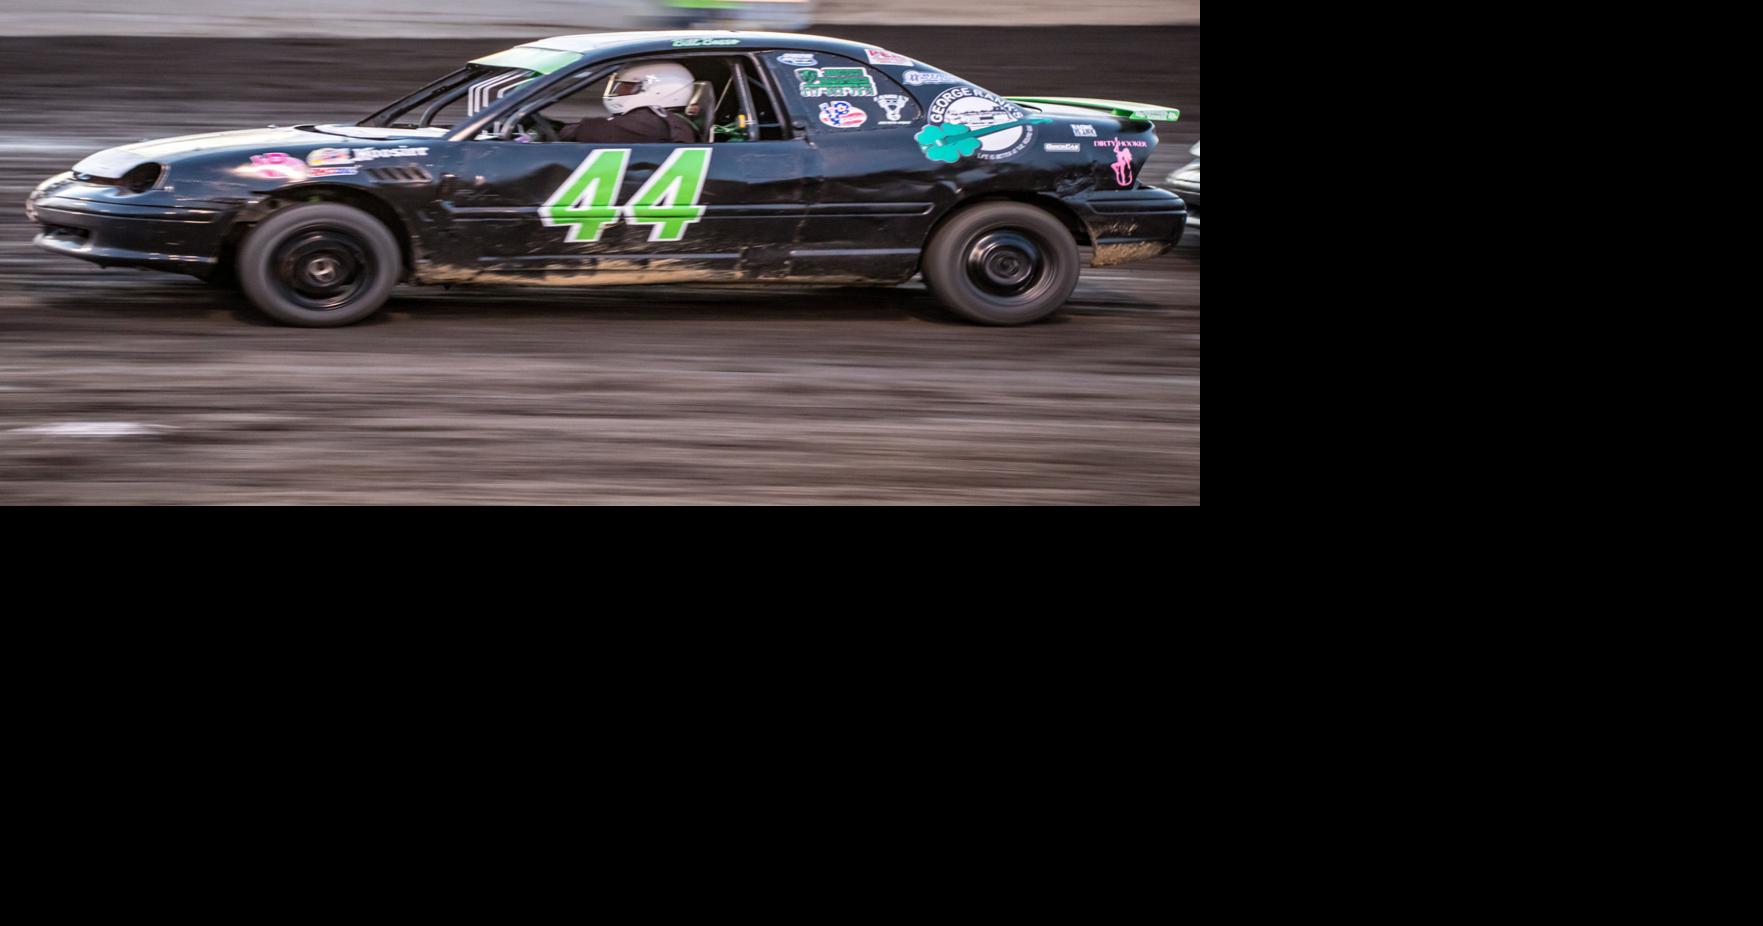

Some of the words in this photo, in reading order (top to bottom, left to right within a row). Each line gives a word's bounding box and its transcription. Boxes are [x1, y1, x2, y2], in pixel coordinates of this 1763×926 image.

[930, 87, 973, 123] GEORGE
[973, 89, 1024, 119] RANK'S
[1093, 140, 1117, 148] DIRTY
[1118, 140, 1147, 148] HOOKER
[537, 147, 713, 243] 44
